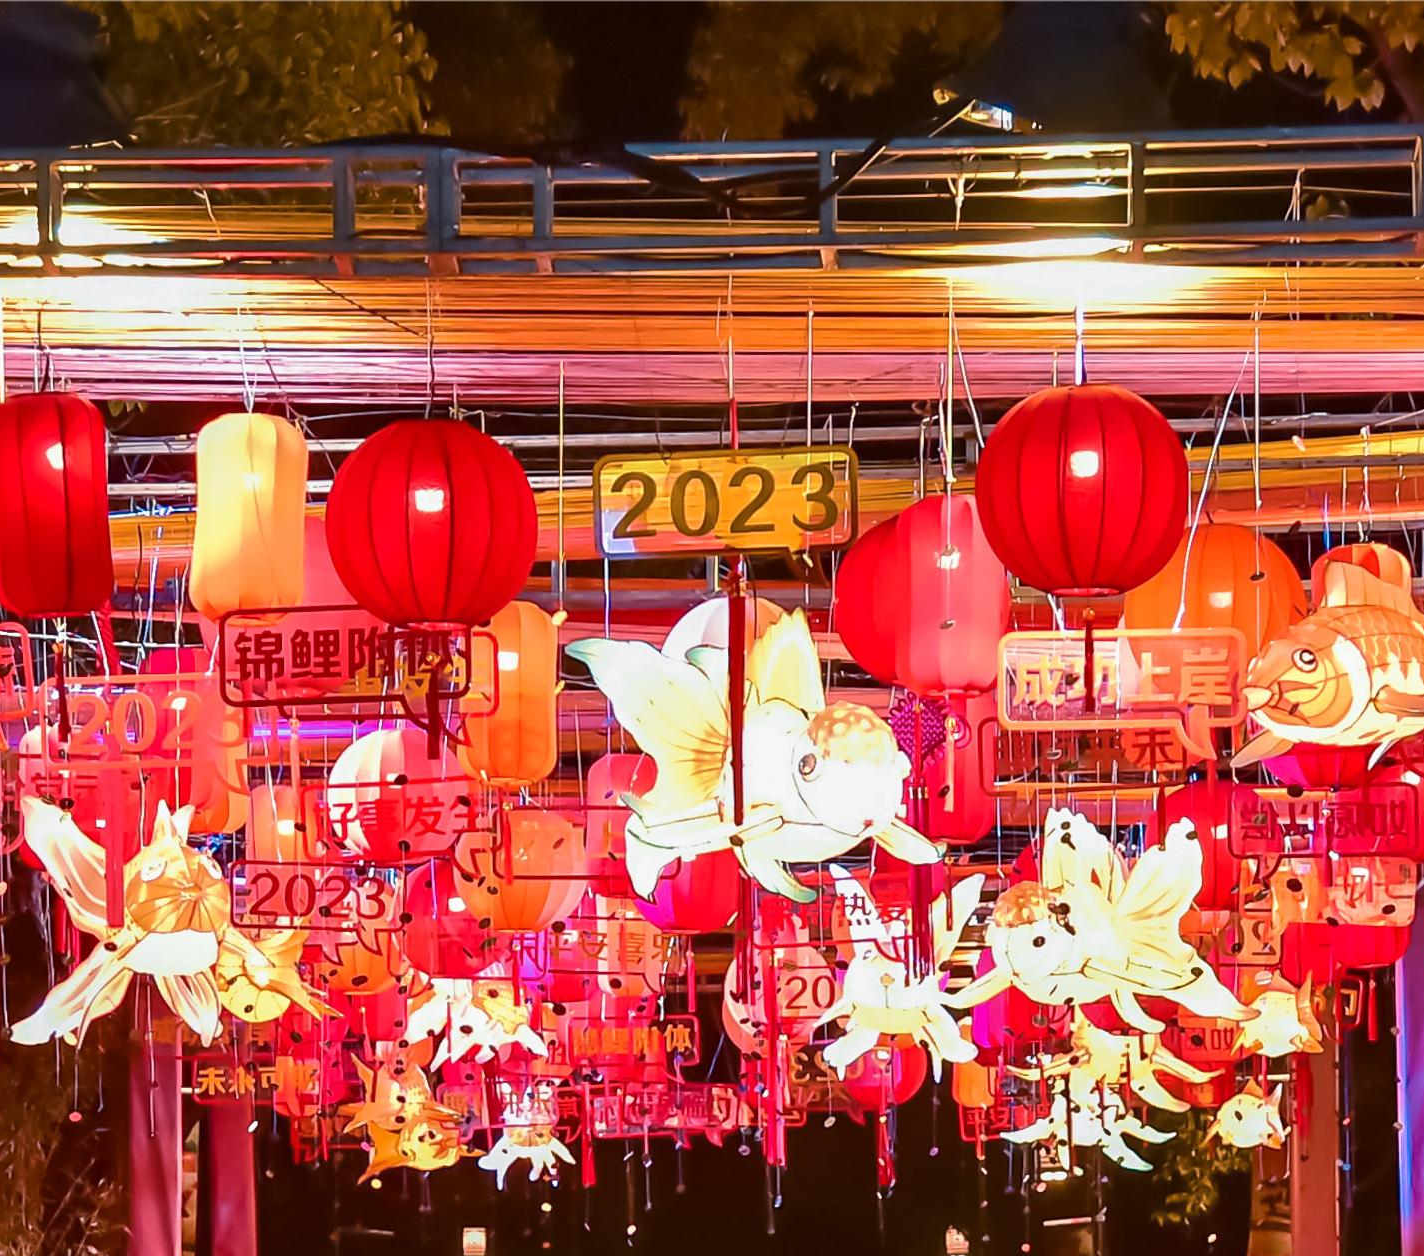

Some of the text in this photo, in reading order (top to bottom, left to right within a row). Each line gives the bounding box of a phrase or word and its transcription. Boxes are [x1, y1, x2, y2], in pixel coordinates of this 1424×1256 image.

[610, 463, 838, 540] 2023
[1012, 646, 1232, 707] 成功上岸
[249, 870, 386, 920] 2023
